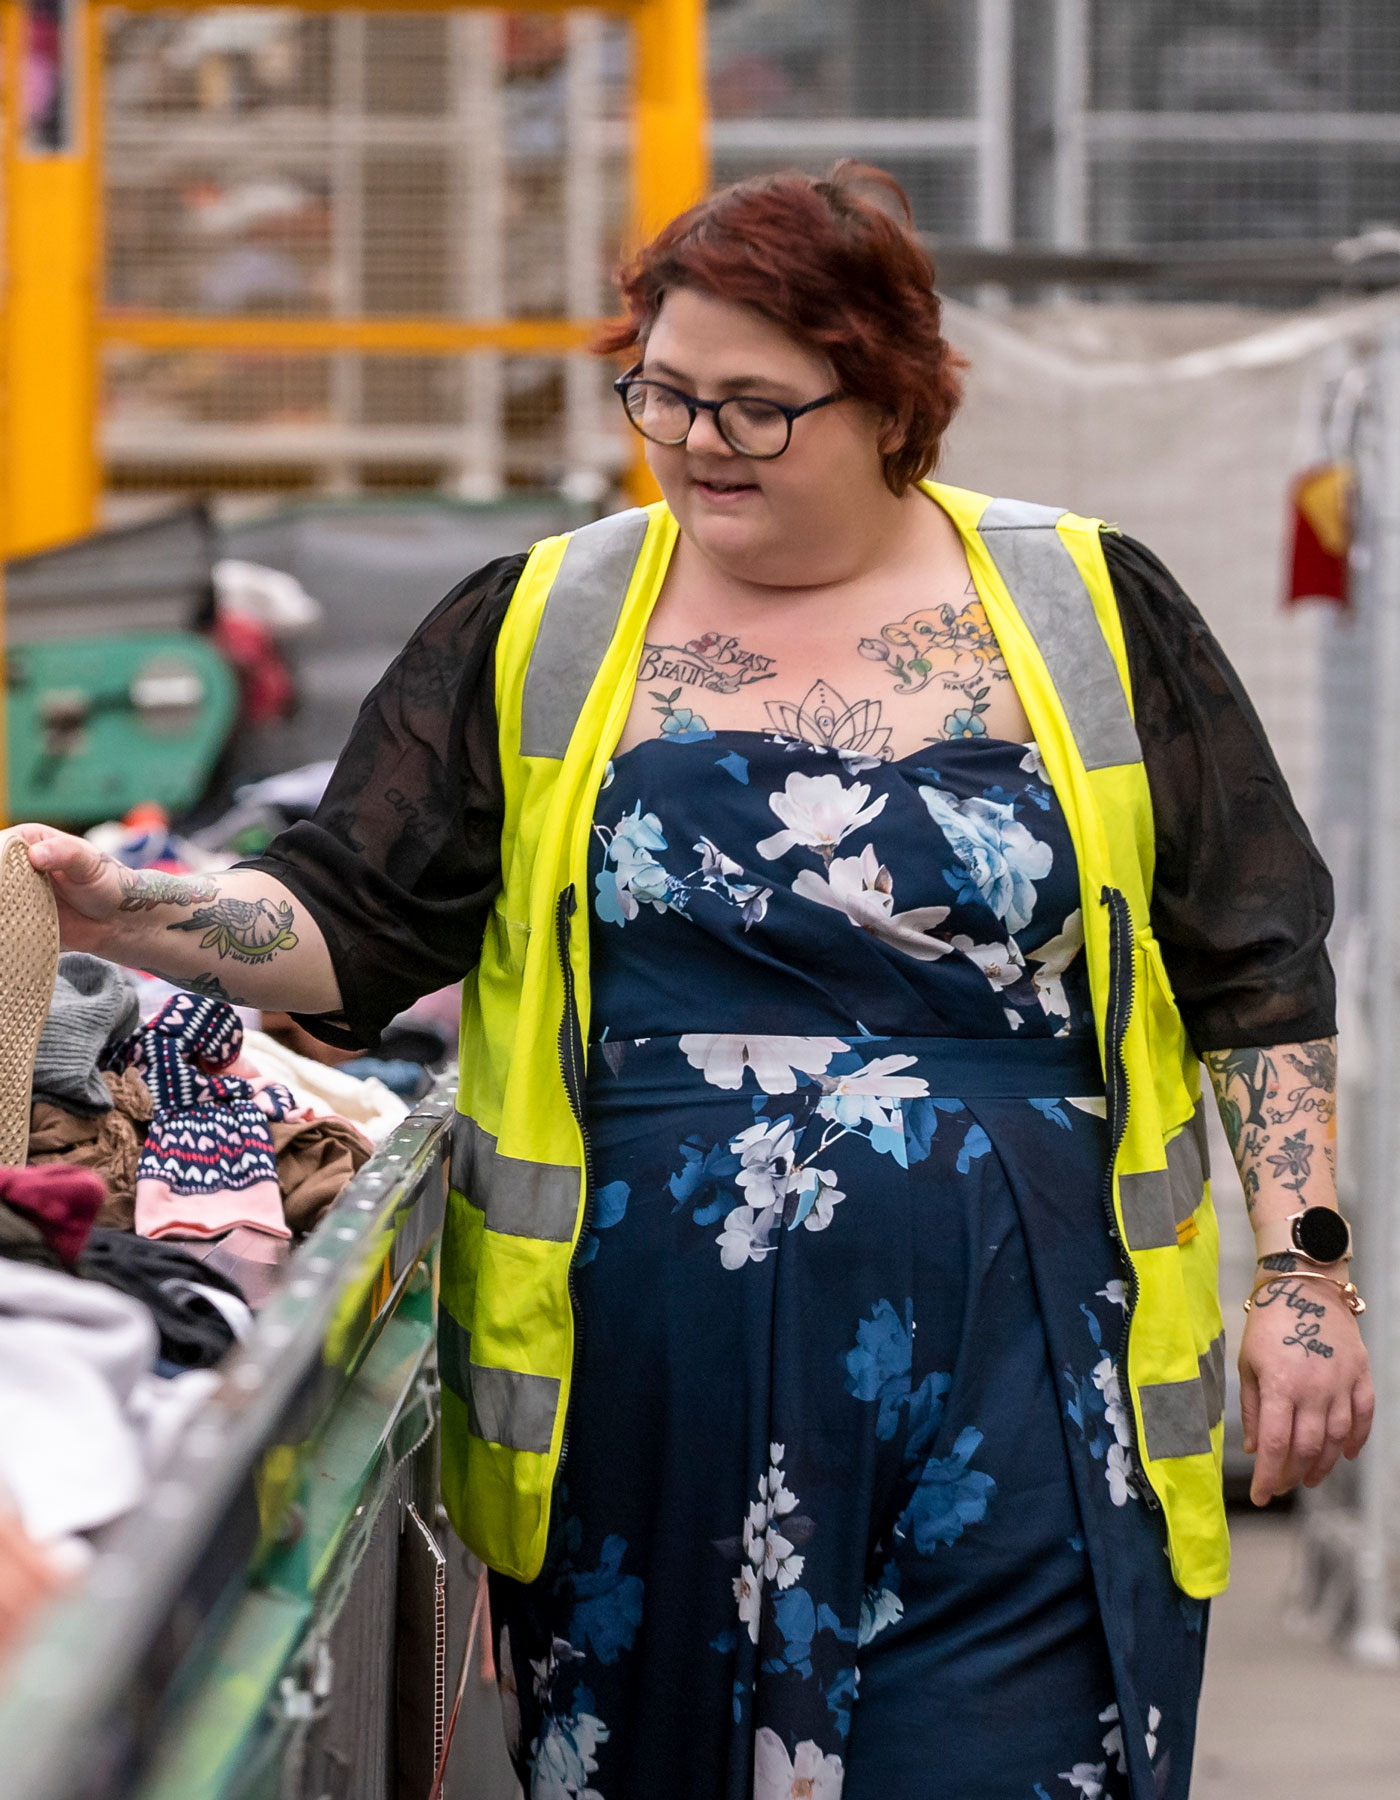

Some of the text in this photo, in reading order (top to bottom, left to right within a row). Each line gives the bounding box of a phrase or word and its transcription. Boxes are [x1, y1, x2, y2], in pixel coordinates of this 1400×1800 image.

[637, 650, 717, 688] BEAUTY
[716, 634, 777, 672] BEAST
[1254, 1279, 1326, 1319] Hope
